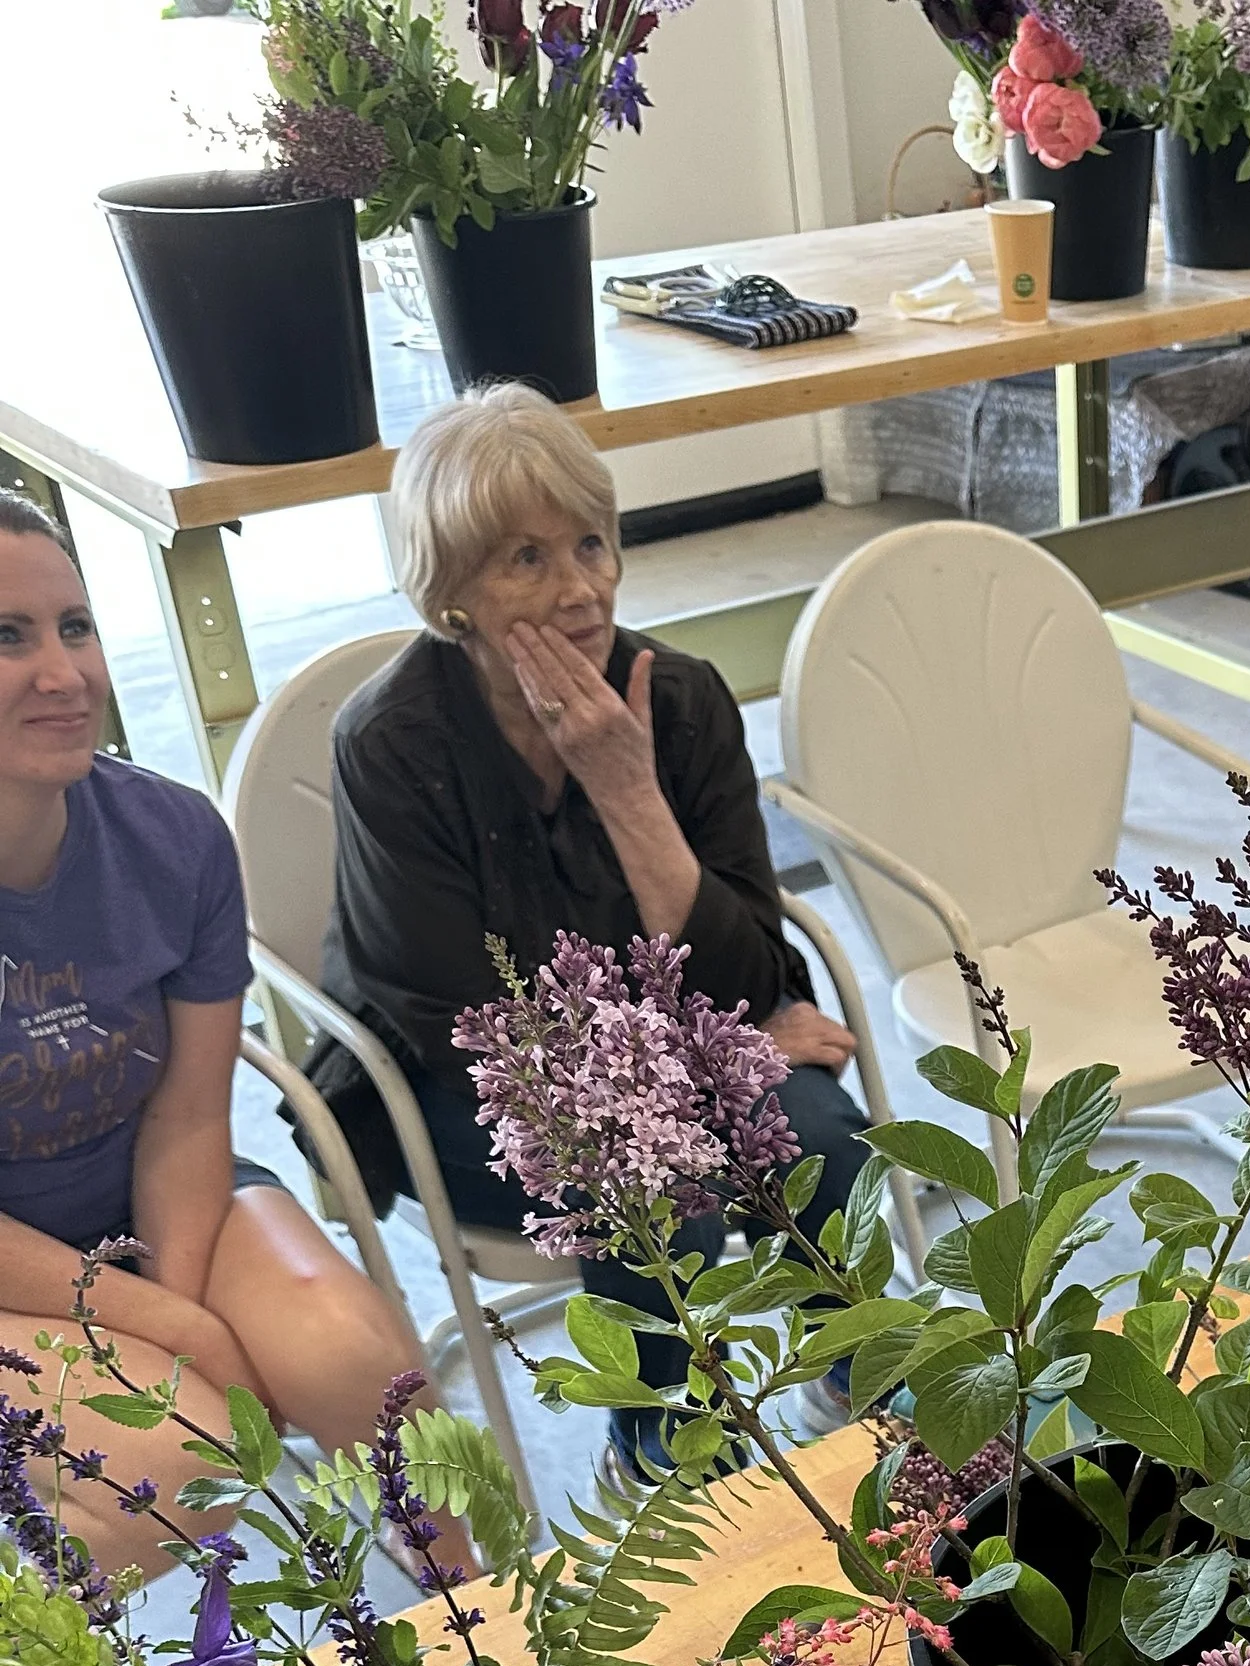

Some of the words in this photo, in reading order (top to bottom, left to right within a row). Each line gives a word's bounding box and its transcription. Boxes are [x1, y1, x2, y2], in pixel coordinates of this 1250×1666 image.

[33, 1002, 88, 1024] ANOTHER
[27, 1023, 60, 1038] NAME
[62, 1014, 89, 1030] FOR
